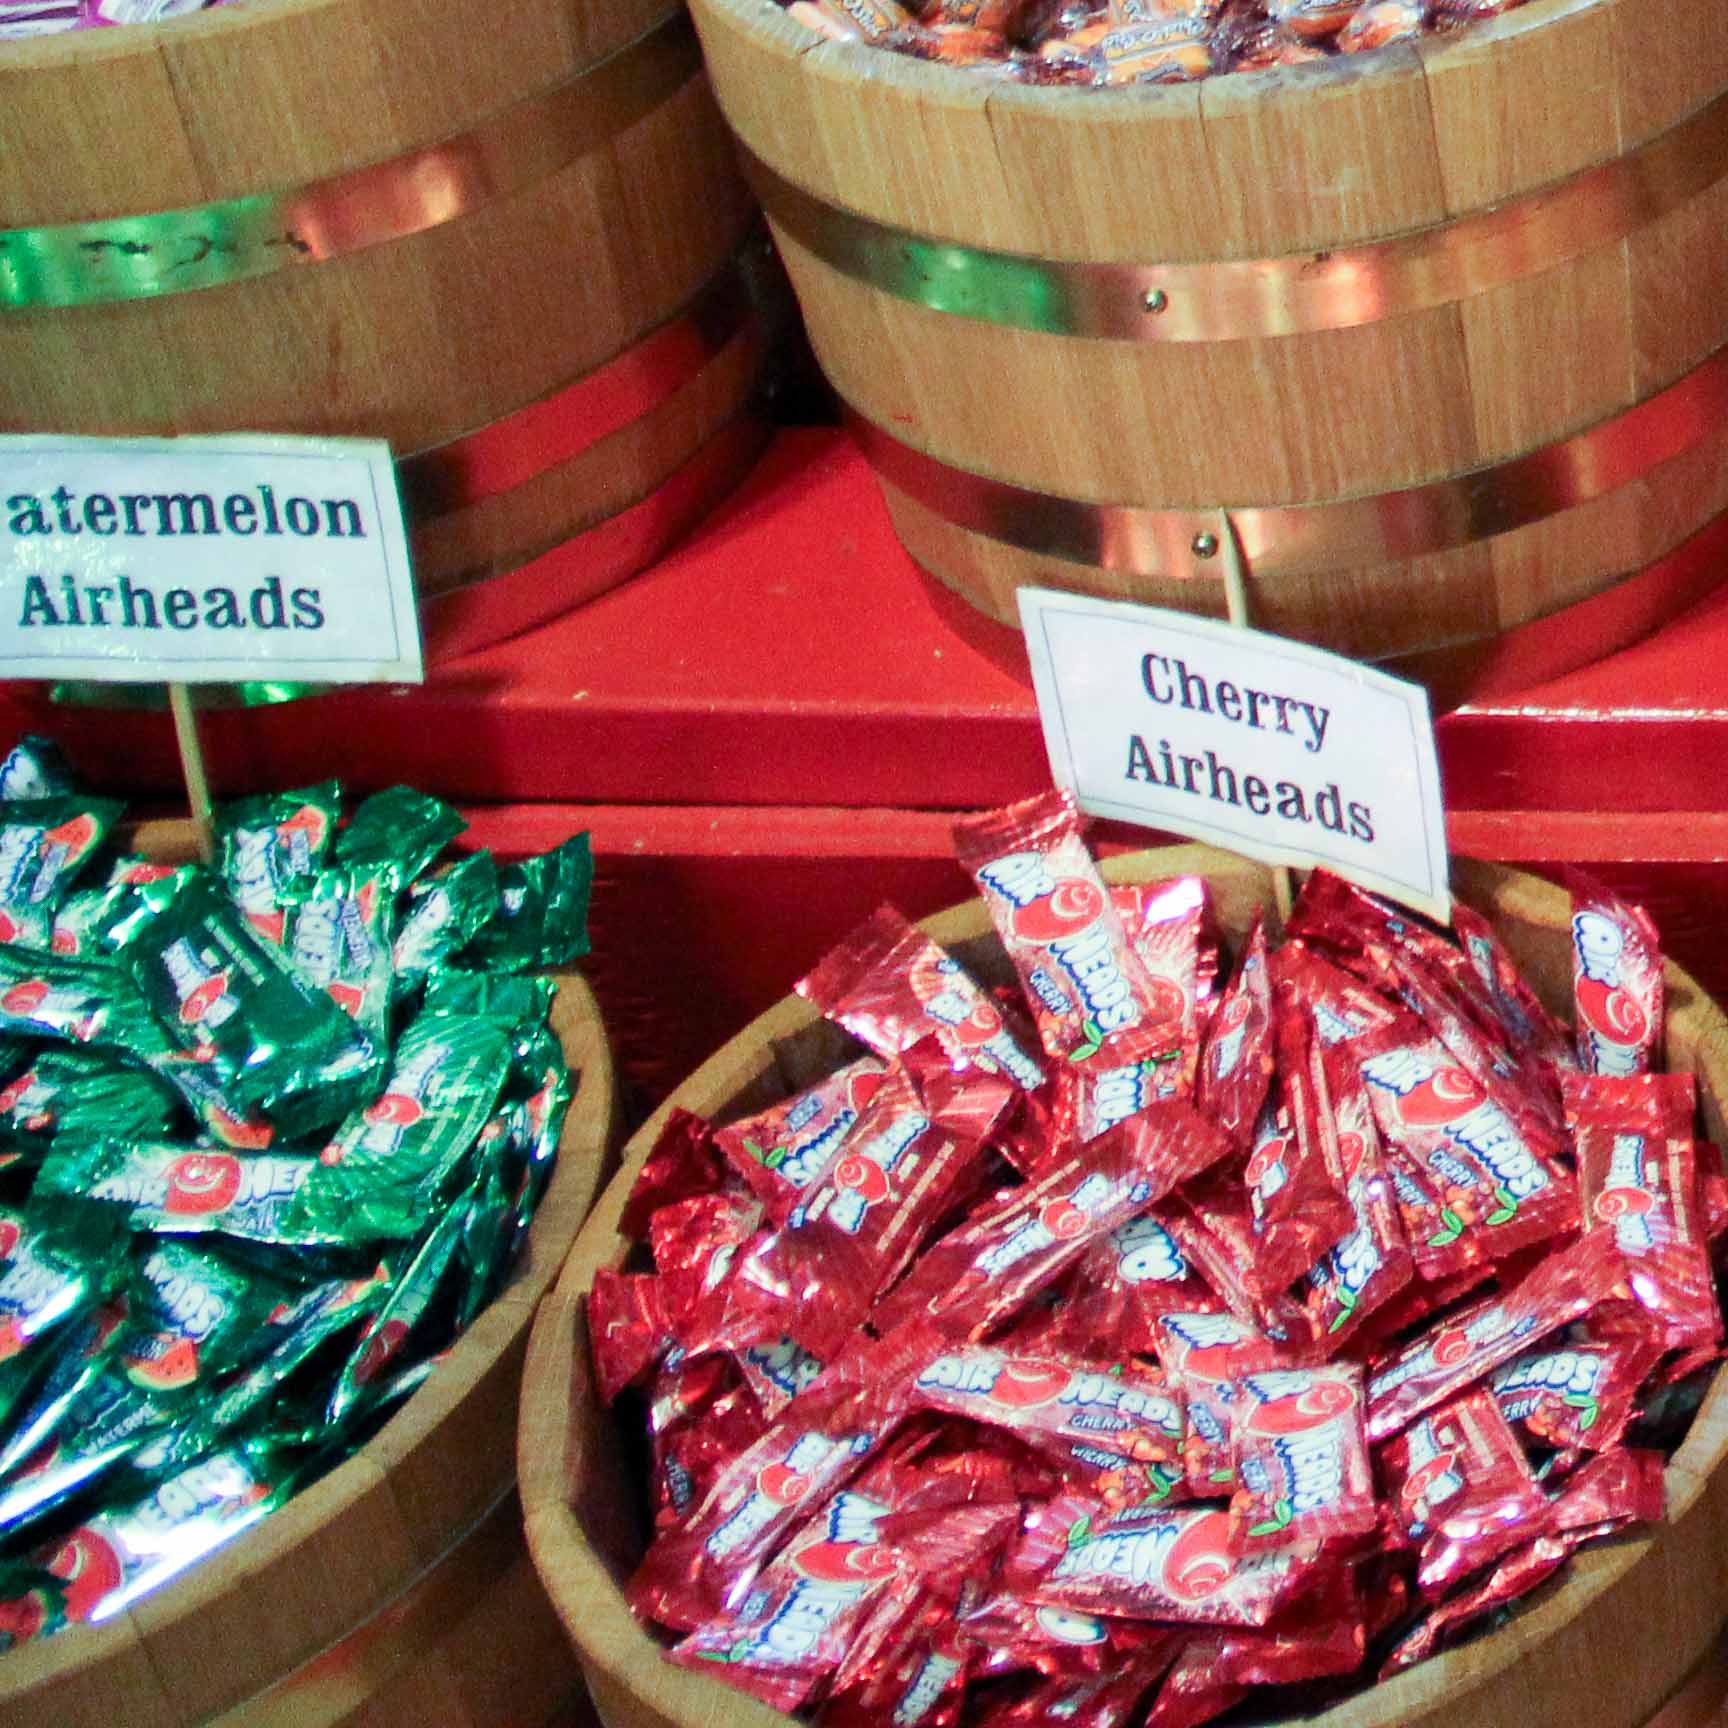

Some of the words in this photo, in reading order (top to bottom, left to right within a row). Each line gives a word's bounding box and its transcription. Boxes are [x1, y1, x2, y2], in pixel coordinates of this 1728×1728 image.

[18, 575, 326, 631] Airheads
[1140, 652, 1331, 754] Cherry
[1124, 734, 1376, 844] Airheads
